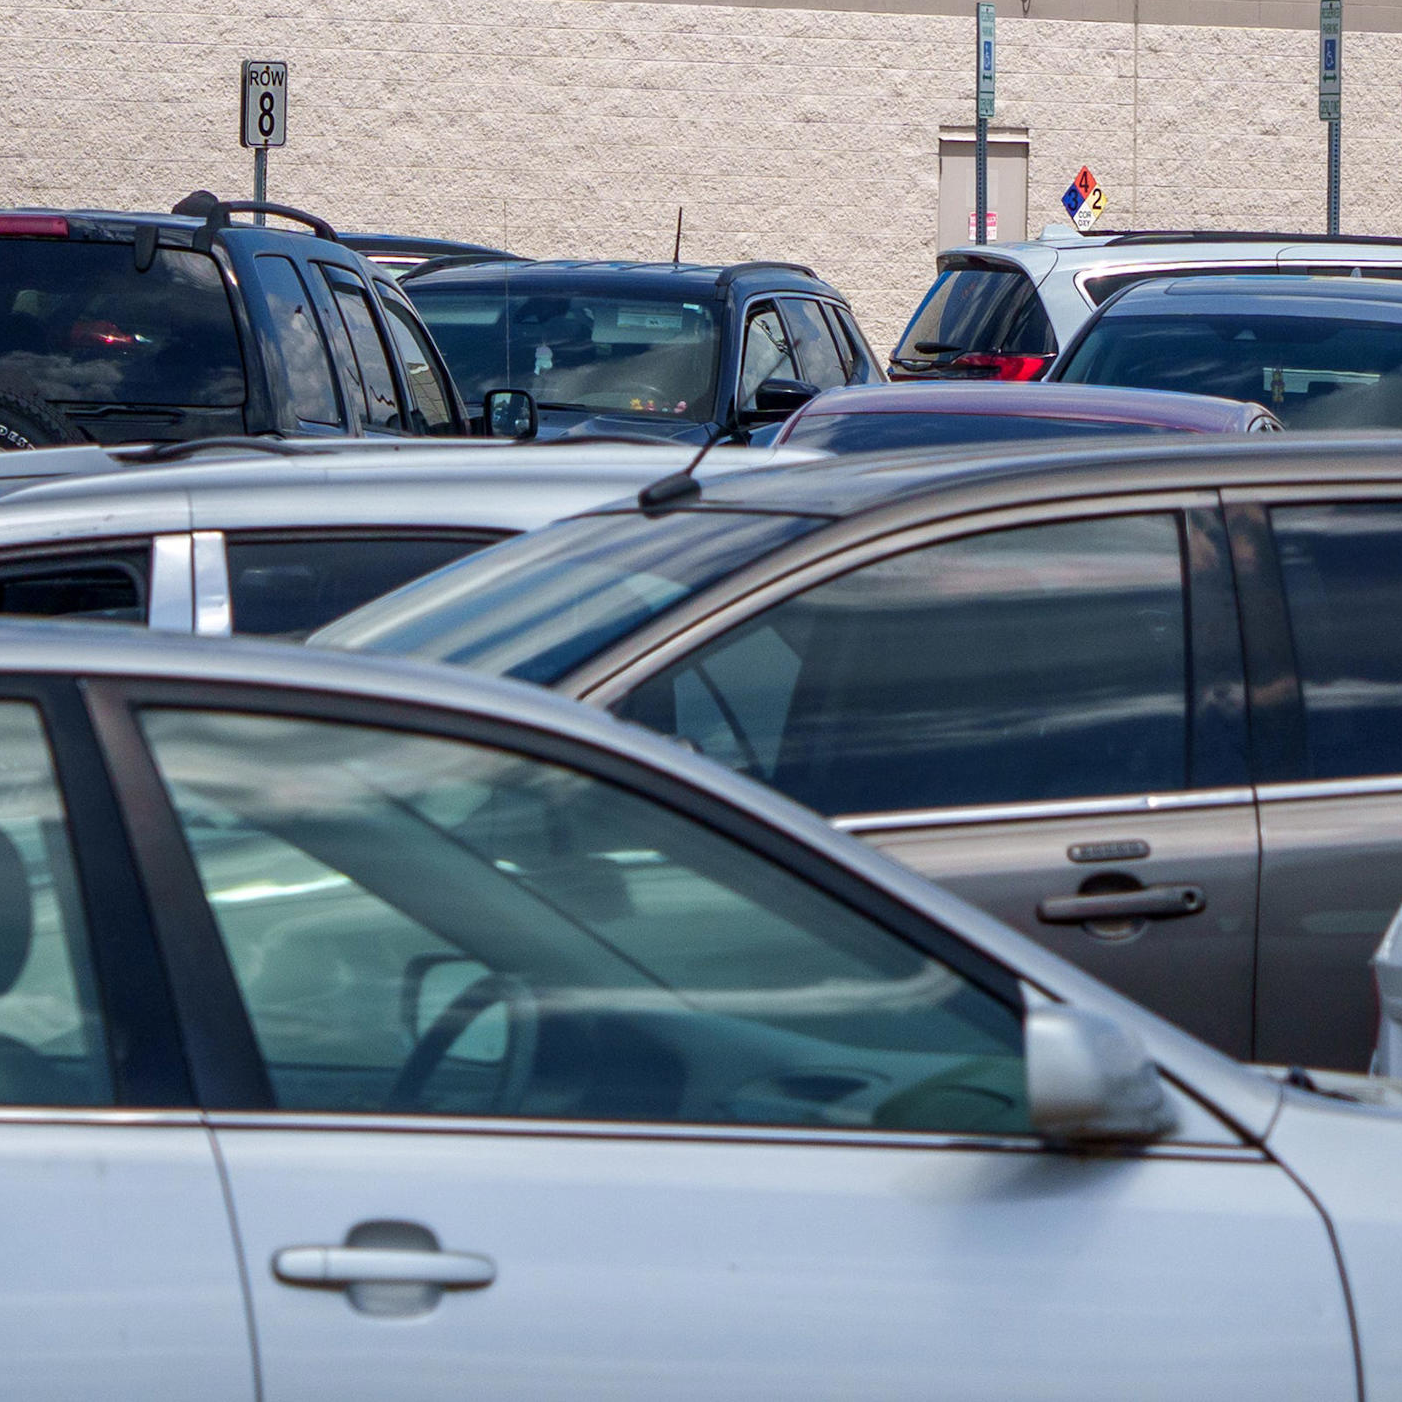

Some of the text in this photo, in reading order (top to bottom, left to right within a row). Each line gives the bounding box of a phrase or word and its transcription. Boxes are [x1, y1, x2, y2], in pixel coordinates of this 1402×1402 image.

[250, 70, 284, 86] ROW
[259, 91, 275, 137] 8
[1079, 171, 1089, 193] 4
[1068, 188, 1102, 211] 3 2
[1078, 210, 1091, 218] COR
